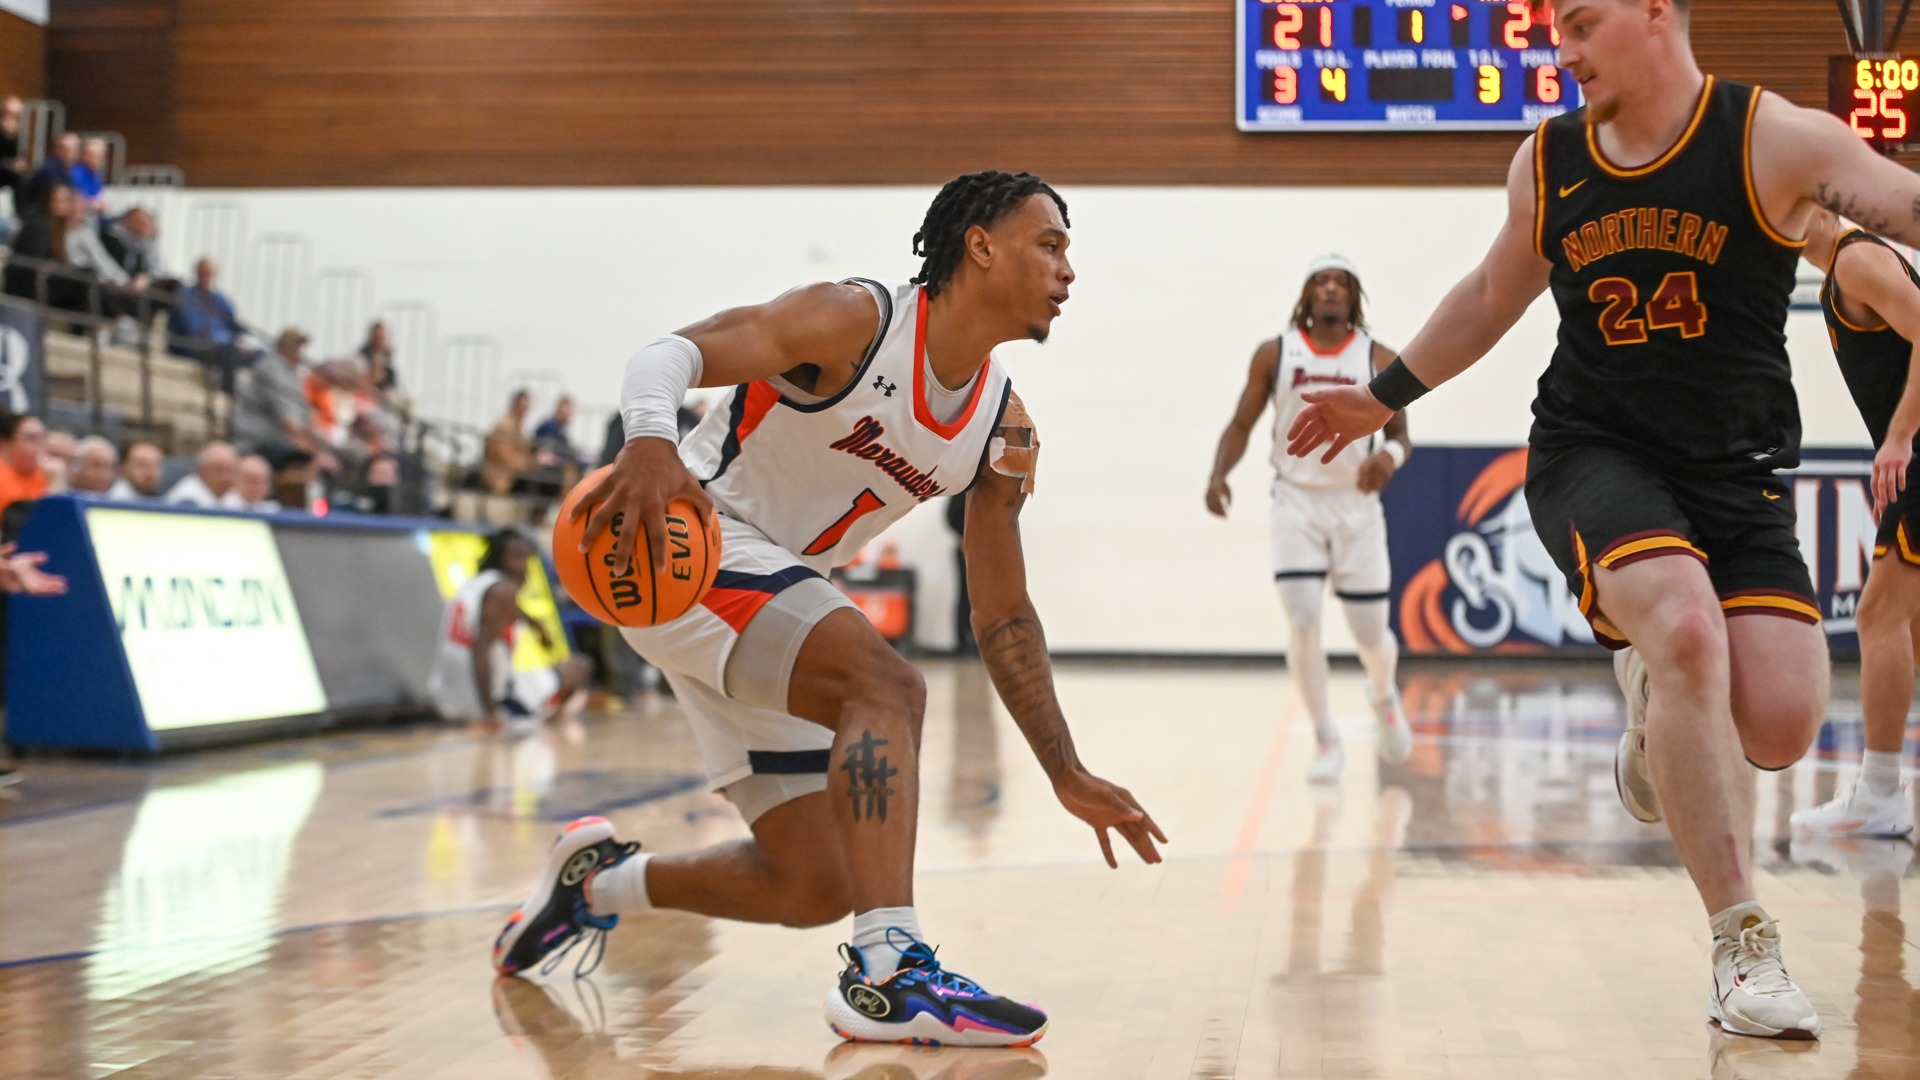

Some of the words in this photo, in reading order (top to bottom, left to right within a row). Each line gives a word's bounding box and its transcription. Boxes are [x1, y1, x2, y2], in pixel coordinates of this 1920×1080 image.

[1274, 3, 1333, 50] 21
[1411, 9, 1424, 44] 1
[1274, 65, 1298, 104] 3
[1320, 67, 1347, 102] 4
[1478, 65, 1501, 104] 3
[1536, 65, 1560, 103] 6
[1856, 59, 1919, 91] 6:00
[1850, 88, 1906, 138] 25
[1561, 207, 1729, 272] NORTHERN
[1588, 271, 1708, 346] 24
[801, 487, 887, 556] 1
